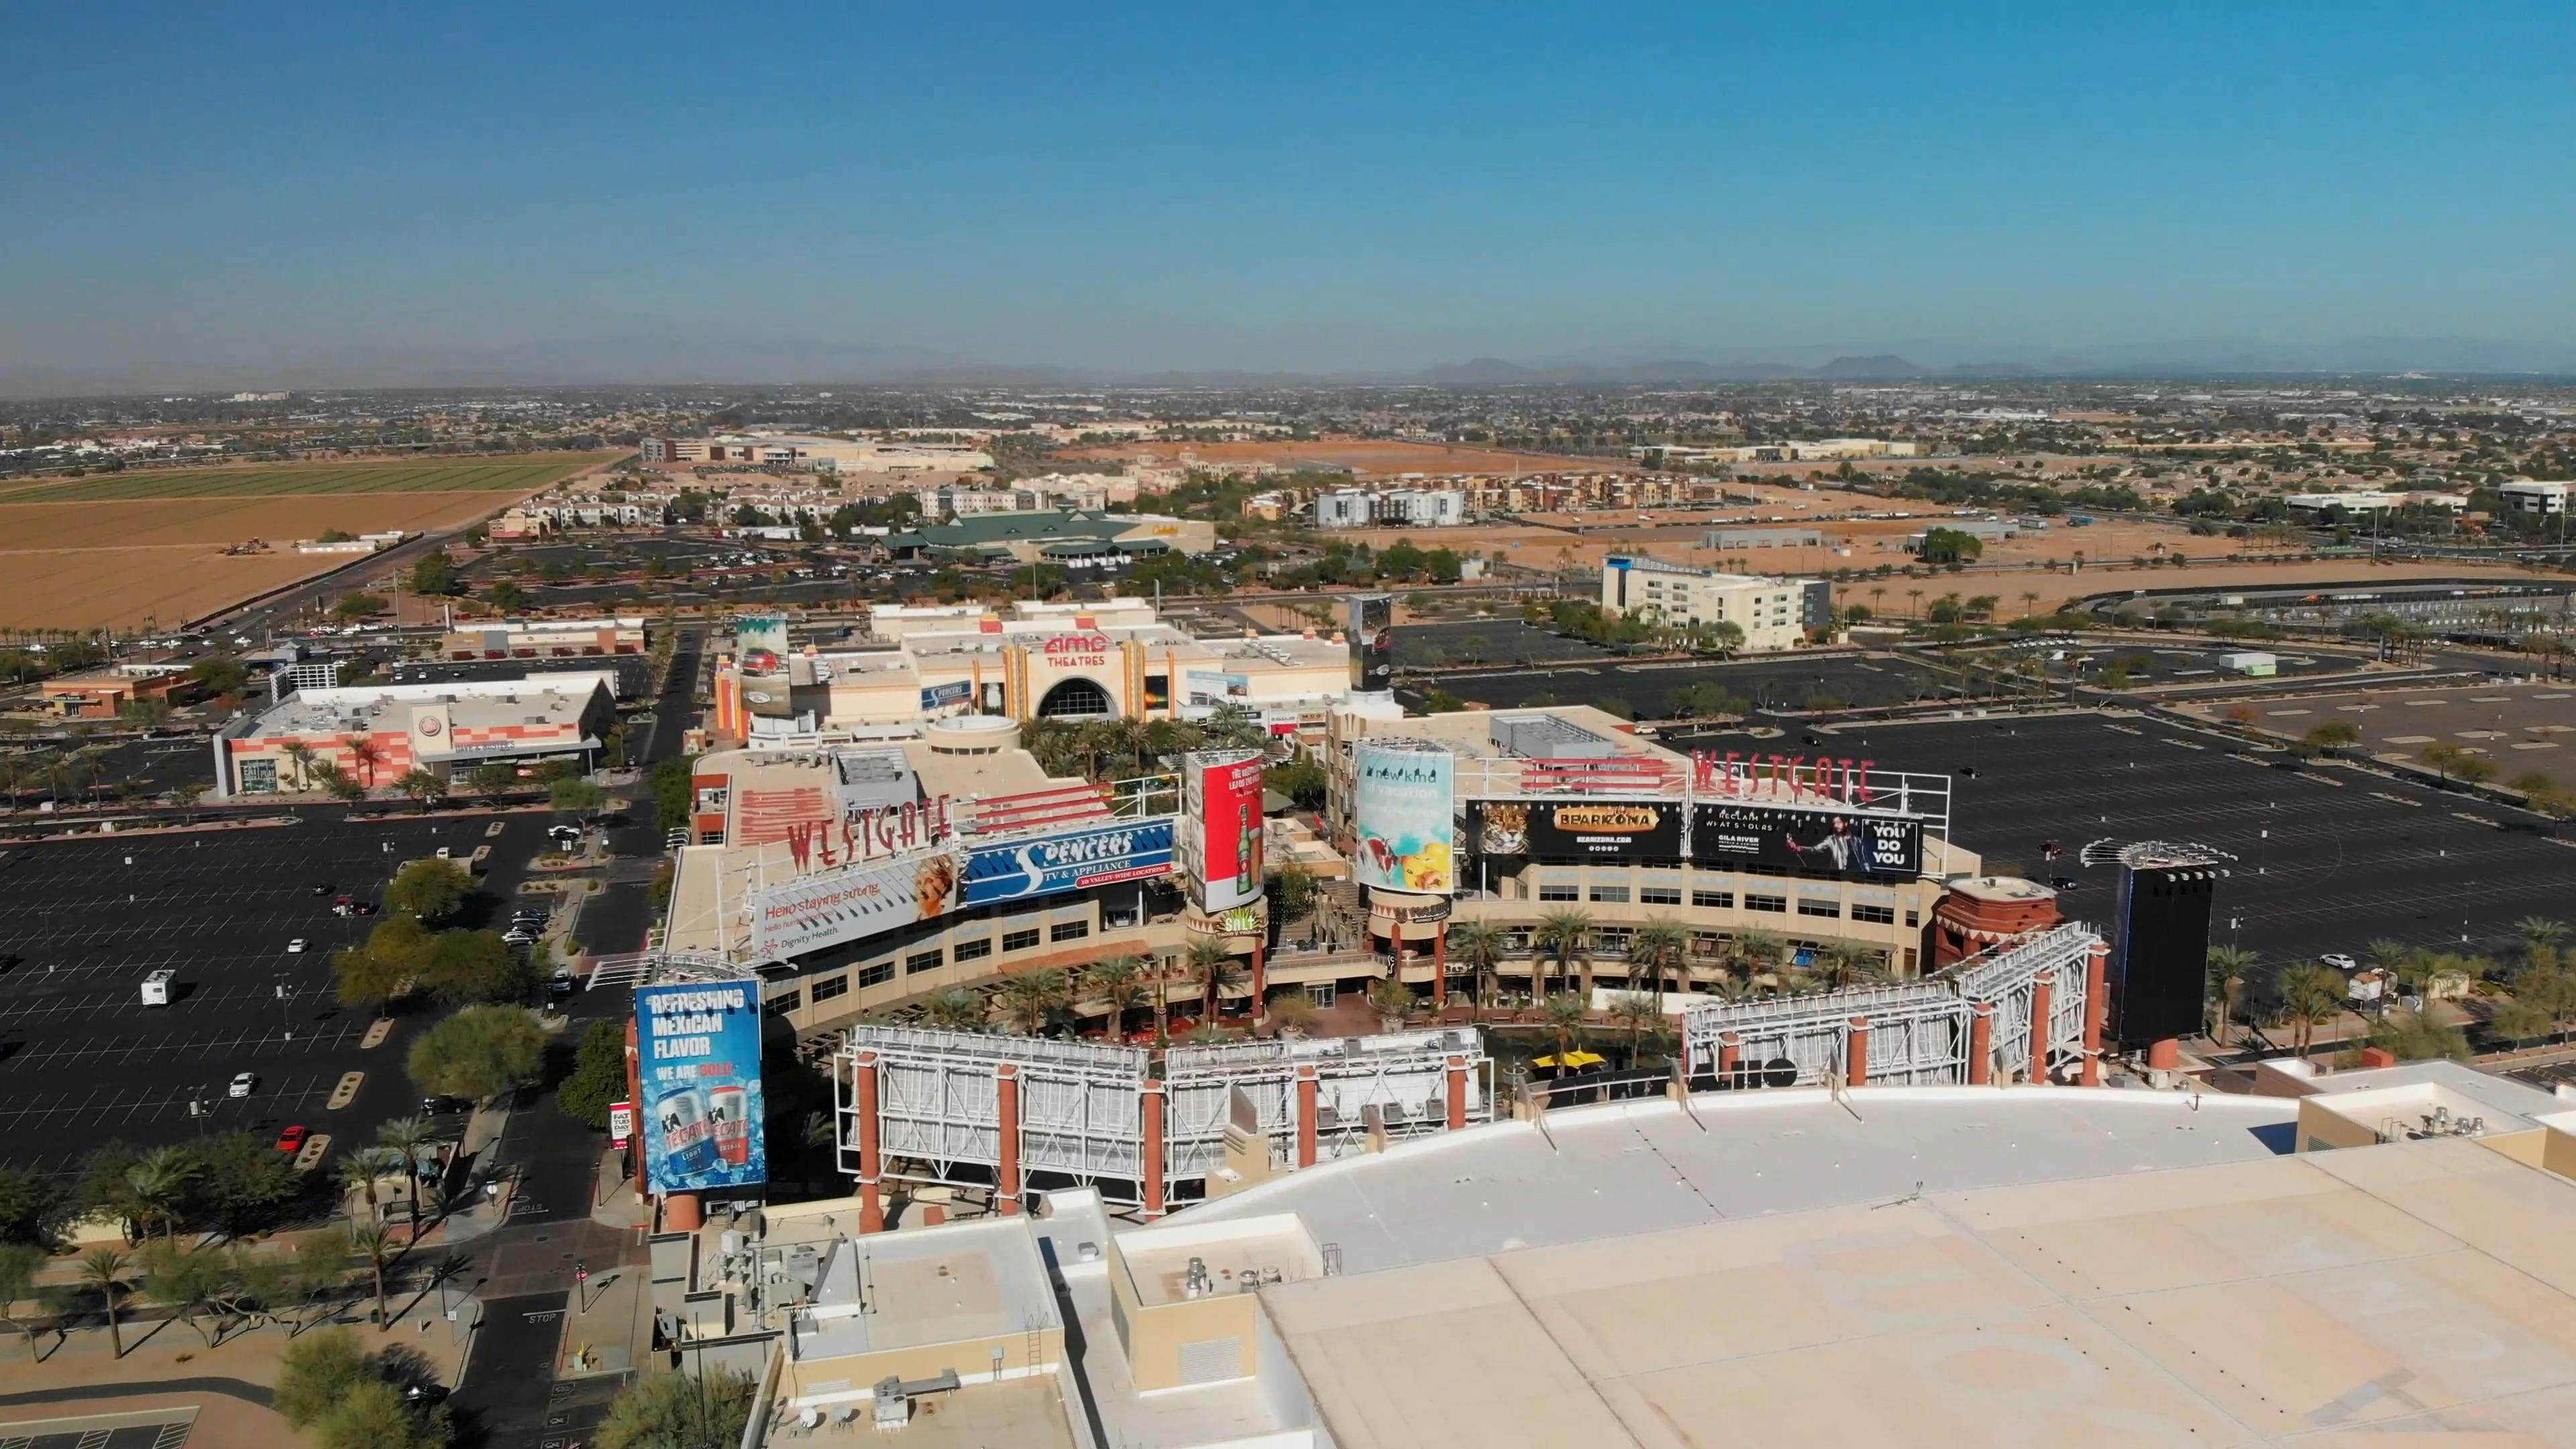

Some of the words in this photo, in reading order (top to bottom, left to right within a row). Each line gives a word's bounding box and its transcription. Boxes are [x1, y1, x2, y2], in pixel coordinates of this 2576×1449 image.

[1047, 656, 1104, 667] THEATRES
[1693, 748, 1874, 802] WESTGATE
[1560, 814, 1650, 826] BEARIZONA
[788, 794, 952, 875] WESTGATE
[1873, 826, 1906, 839] YOU
[1878, 839, 1901, 851] DO
[1873, 852, 1905, 865] YOU
[1044, 872, 1059, 881] TV
[1061, 871, 1069, 879] &
[1071, 859, 1132, 877] APPLIANCE
[1090, 872, 1132, 884] VALLEY-WIDE
[1132, 865, 1167, 877] LOCATIONS
[1225, 916, 1255, 932] SALT
[781, 934, 811, 949] Dignity
[651, 989, 744, 1014] REFRESHING
[652, 1013, 723, 1037] MEXICAN
[653, 1036, 710, 1059] FLAVOR
[656, 1067, 674, 1081] WE
[676, 1065, 697, 1080] ARE
[711, 1118, 749, 1136] ECATE
[529, 1313, 557, 1324] STOP
